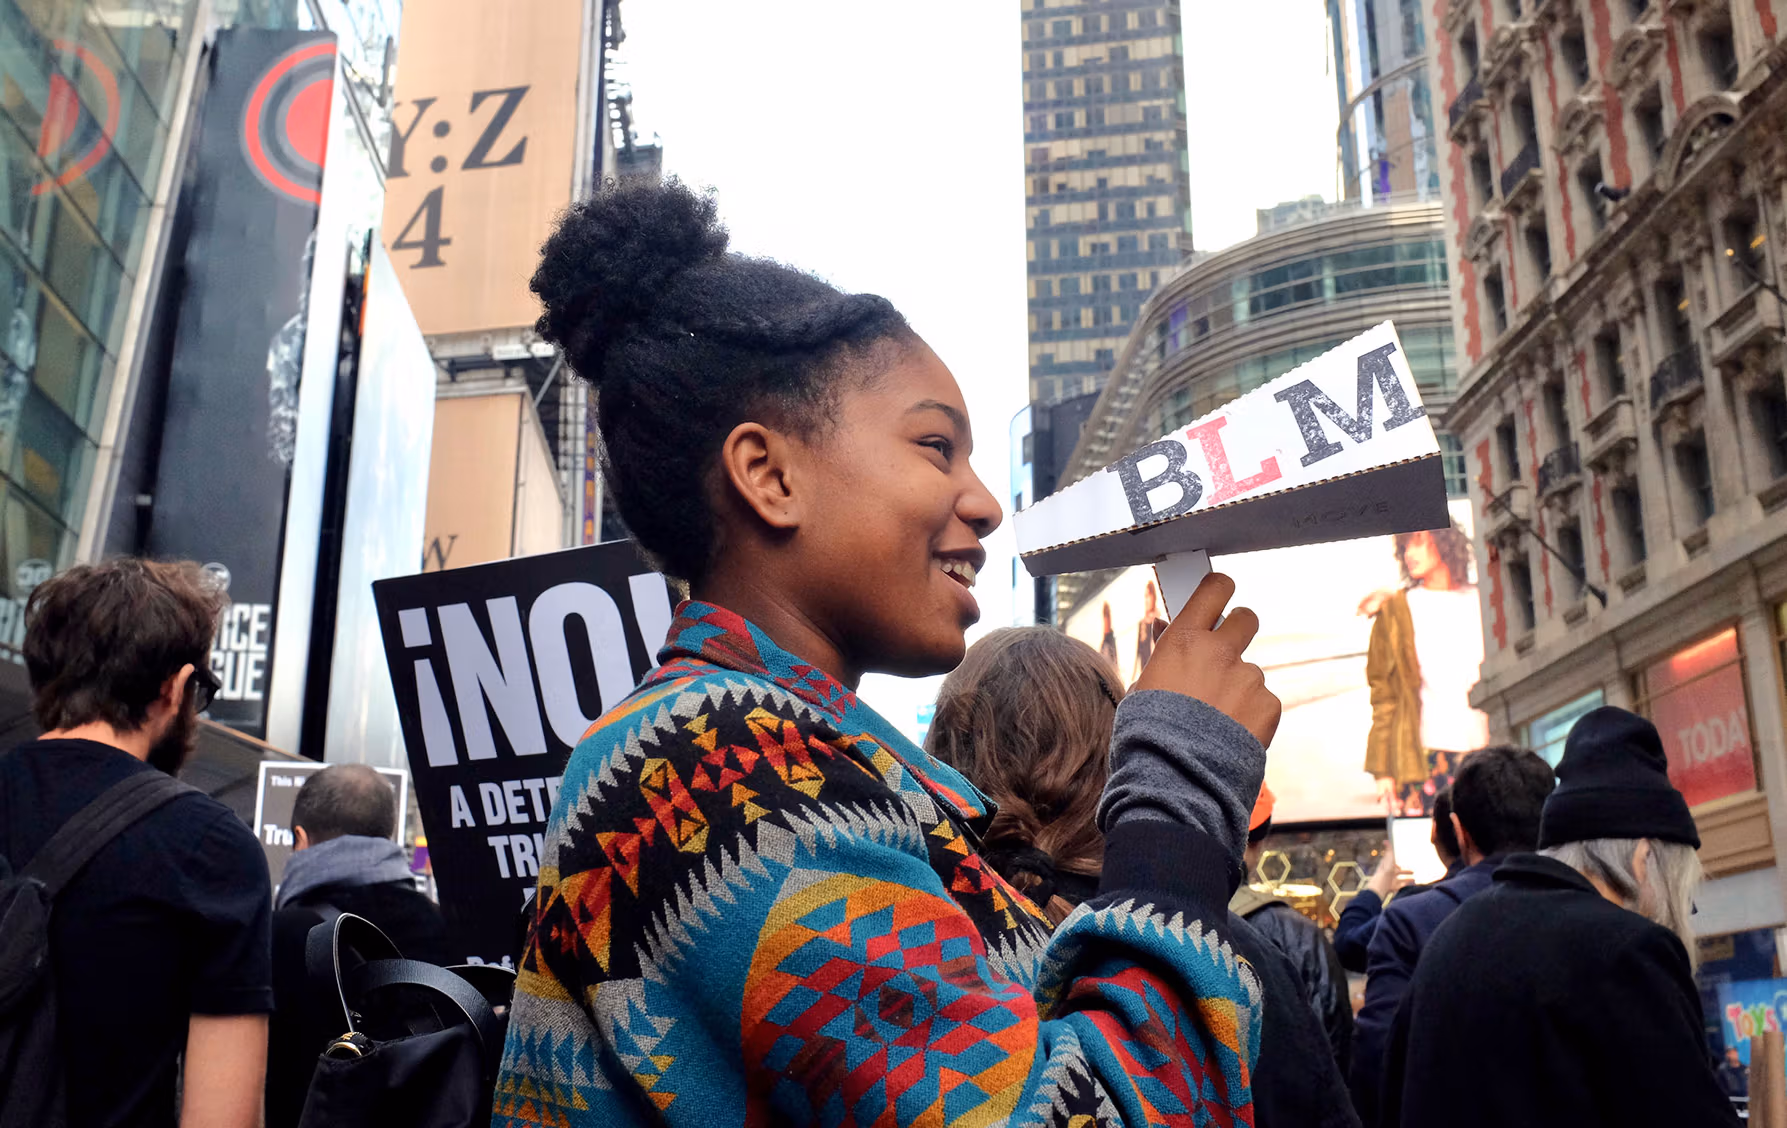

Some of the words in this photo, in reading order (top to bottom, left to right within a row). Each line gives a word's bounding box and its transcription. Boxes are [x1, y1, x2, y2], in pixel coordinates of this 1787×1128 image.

[1107, 341, 1427, 528] BLM
[212, 603, 271, 652] ICE
[1678, 704, 1746, 769] TODA
[271, 775, 292, 787] This
[450, 784, 476, 828] A
